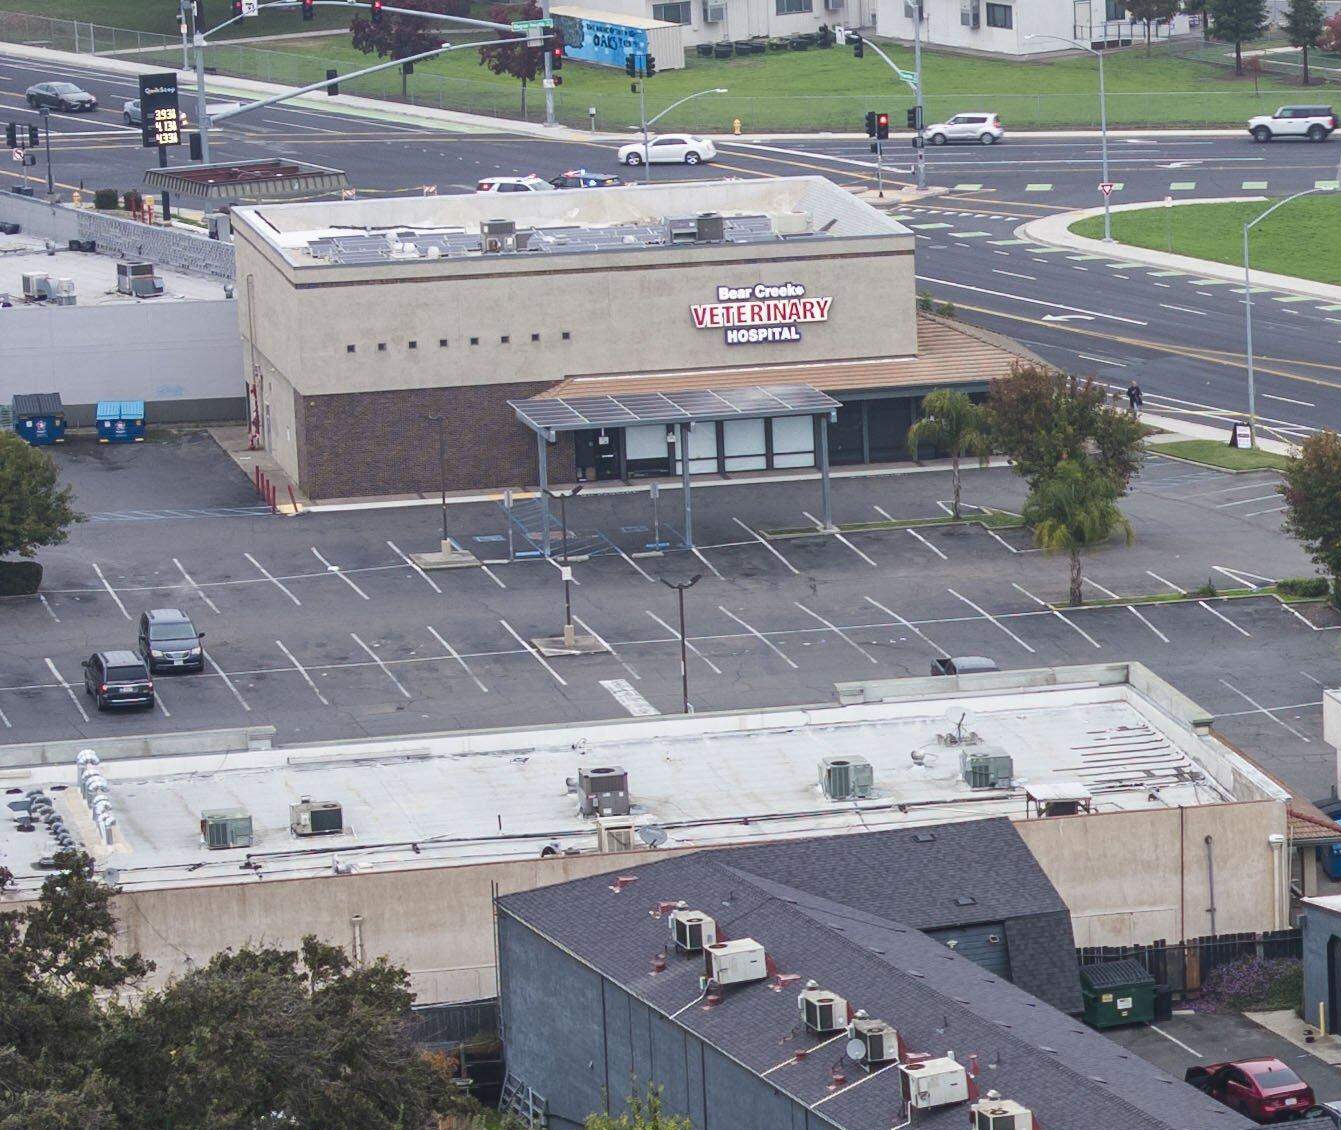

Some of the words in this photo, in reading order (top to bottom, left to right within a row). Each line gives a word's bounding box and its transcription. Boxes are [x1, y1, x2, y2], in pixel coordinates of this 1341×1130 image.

[718, 286, 752, 300] Bear
[692, 299, 829, 327] VETERINARY
[727, 326, 800, 343] HOSPITAL
